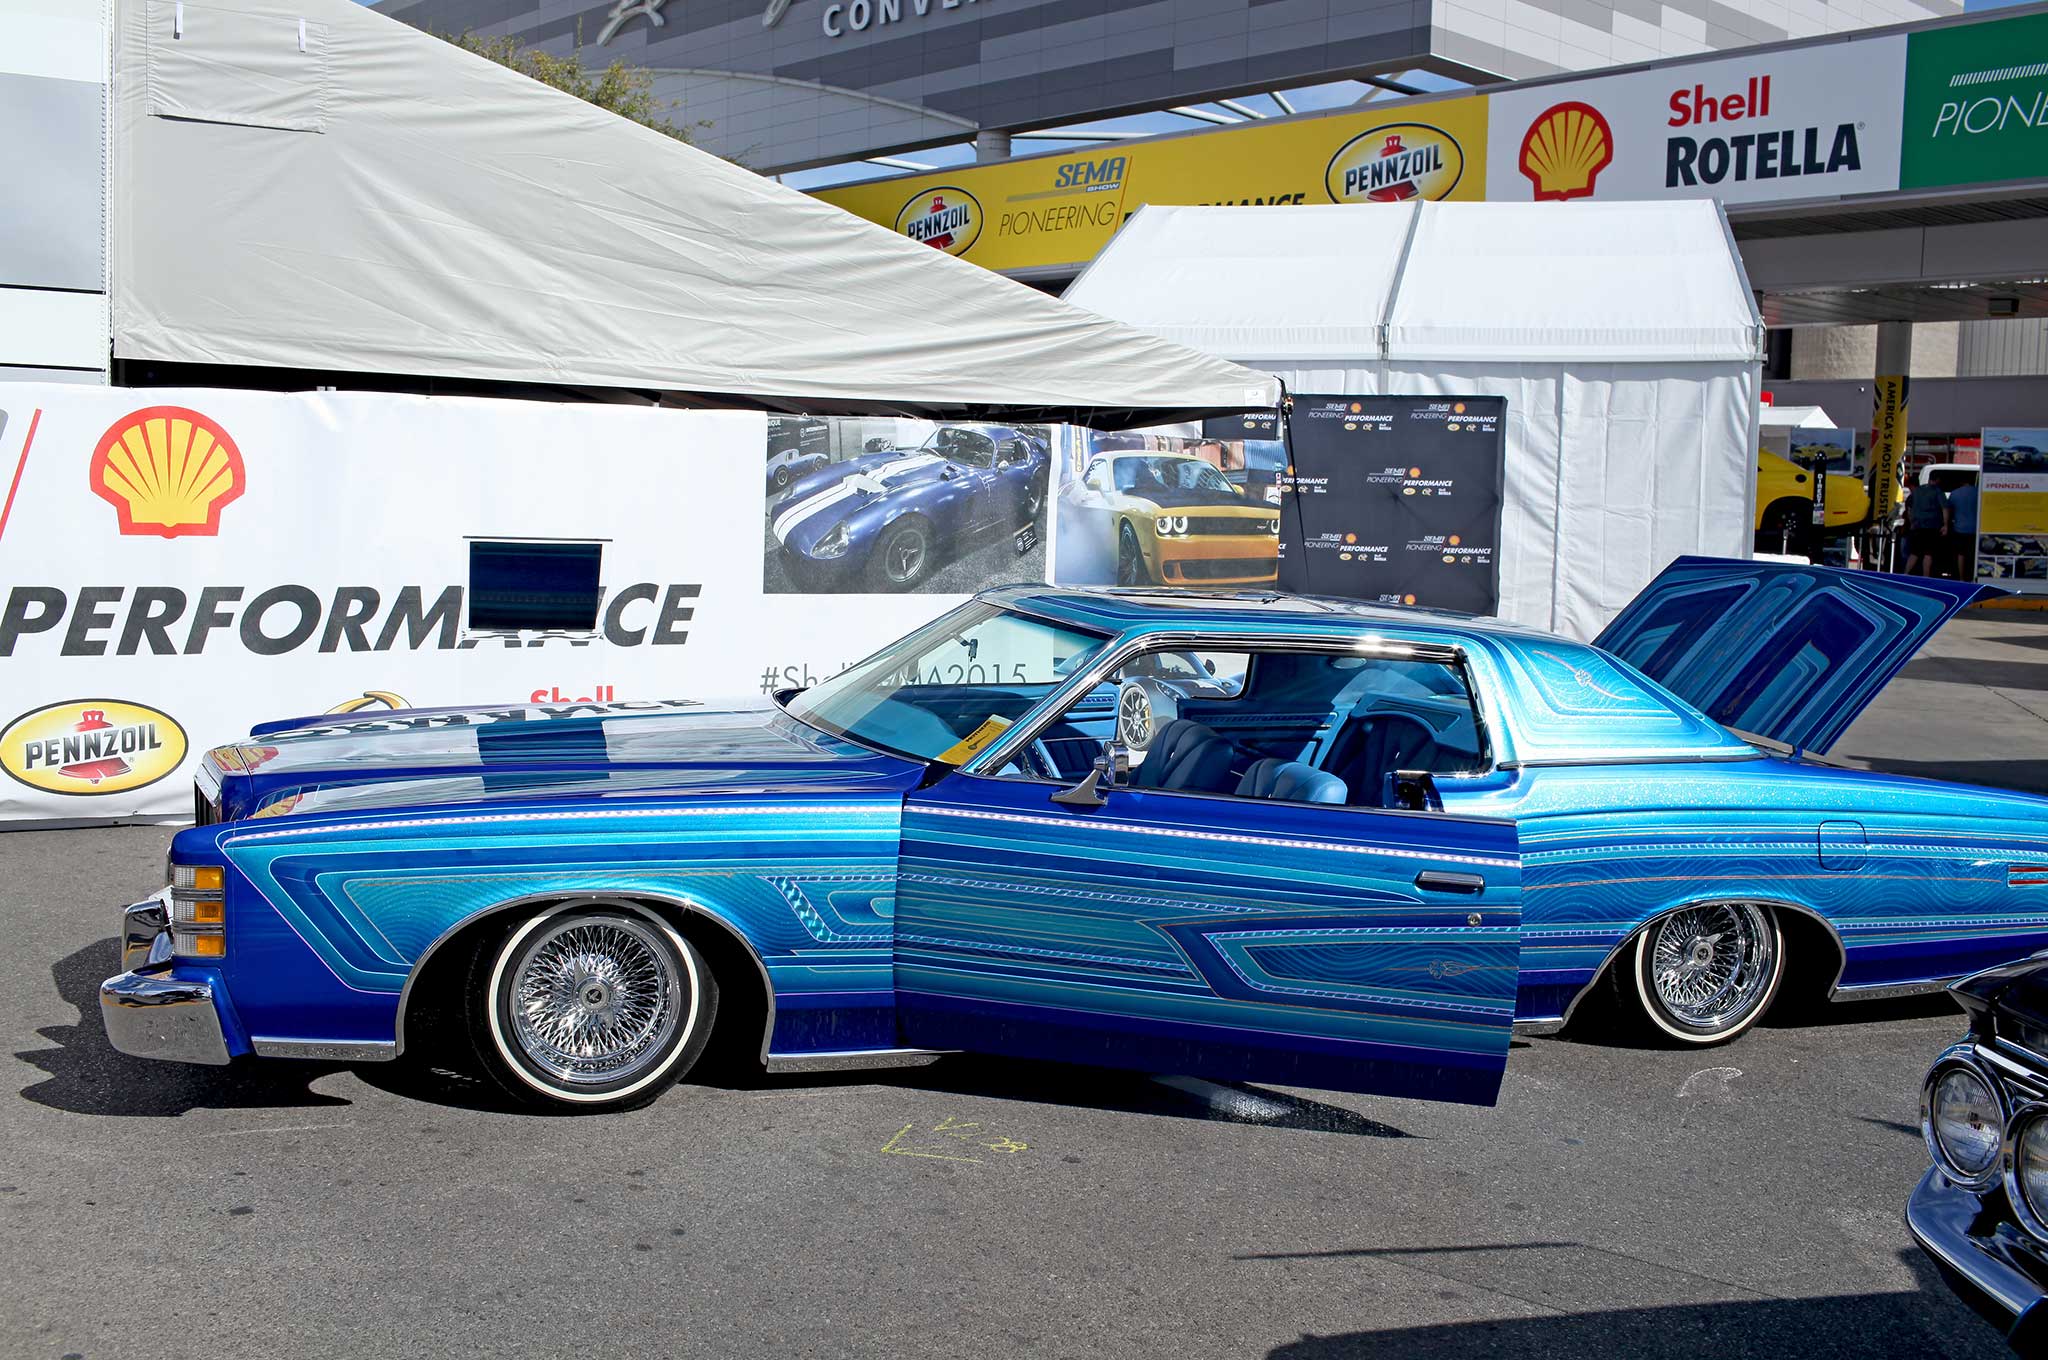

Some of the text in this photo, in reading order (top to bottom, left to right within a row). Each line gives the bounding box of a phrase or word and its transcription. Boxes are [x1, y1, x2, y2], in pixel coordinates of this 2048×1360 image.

[823, 0, 984, 37] CONV
[1667, 75, 1771, 127] Shell
[1055, 157, 1126, 188] SEMA
[1344, 144, 1443, 196] PENNZOIL
[1665, 123, 1861, 188] ROTELLA
[1087, 183, 1119, 192] SHOW
[907, 204, 970, 241] PENNZOIL
[999, 201, 1116, 237] PIONEERING
[1447, 415, 1497, 423] PERFORMANCE
[1879, 381, 1897, 515] AMERICA'S MOST TRUSTE
[1403, 479, 1453, 487] PERFORMANCE
[1339, 545, 1389, 553] PERFORMANCE
[1442, 547, 1492, 555] PERFORMANCE
[0, 584, 703, 657] PERFORMCE
[25, 723, 162, 769] PENNZOIL
